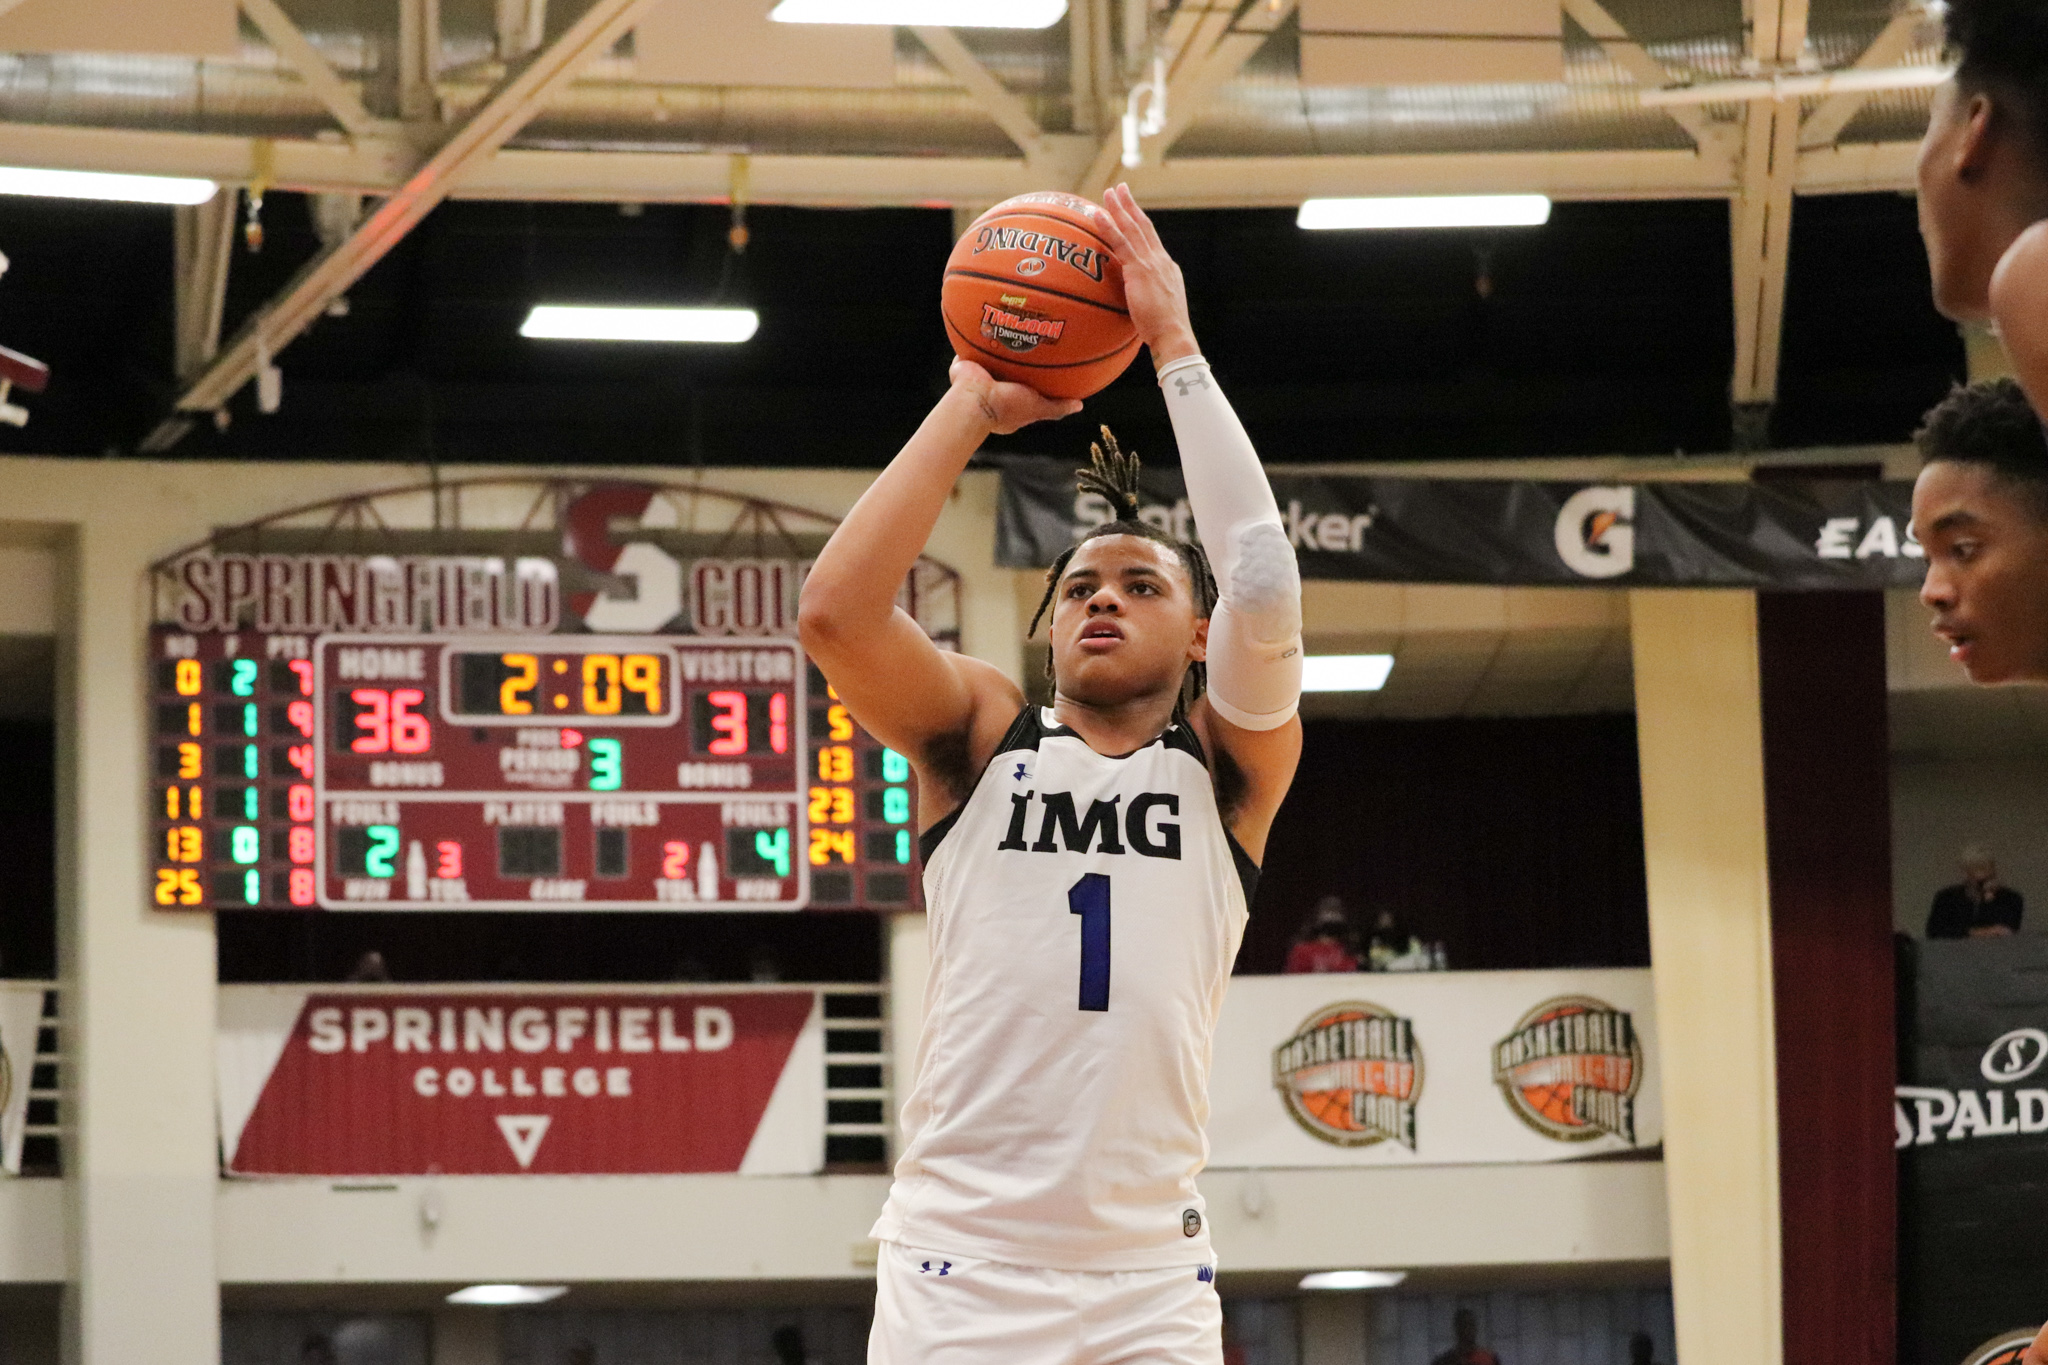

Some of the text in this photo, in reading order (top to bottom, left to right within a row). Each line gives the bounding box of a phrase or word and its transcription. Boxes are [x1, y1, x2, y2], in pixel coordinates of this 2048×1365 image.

[972, 227, 1110, 282] SPALDING
[983, 304, 1065, 339] HOOPHALL
[998, 326, 1039, 346] SPALDING
[1555, 486, 1634, 578] G
[178, 555, 559, 634] SPRINGFIELD
[176, 659, 313, 696] 0 2 7
[339, 648, 424, 680] HOME
[681, 651, 792, 682] VISITOR
[500, 653, 661, 715] 2:09
[188, 701, 313, 738] 1 1 9
[351, 688, 431, 754] 36
[708, 690, 787, 755] 31
[828, 704, 853, 741] 5
[178, 742, 314, 779] 3 1 4
[588, 738, 622, 791] 3
[819, 745, 854, 782] 13
[167, 784, 314, 822] 11 1 0
[331, 801, 399, 825] FOULS
[591, 802, 659, 826] FOULS
[721, 803, 789, 826] FOULS
[808, 787, 855, 823] 23
[998, 789, 1182, 861] IMG
[167, 826, 202, 863] 13
[289, 826, 315, 864] 8
[366, 825, 399, 878] 2
[437, 841, 462, 878] 3
[663, 841, 689, 879] 2
[755, 827, 790, 877] 4
[808, 828, 910, 865] 24 1
[155, 868, 315, 906] 25 1 8
[1067, 872, 1111, 1012] 1
[308, 1007, 734, 1053] SPRINGFIELD
[413, 1067, 632, 1097] COLLEGE
